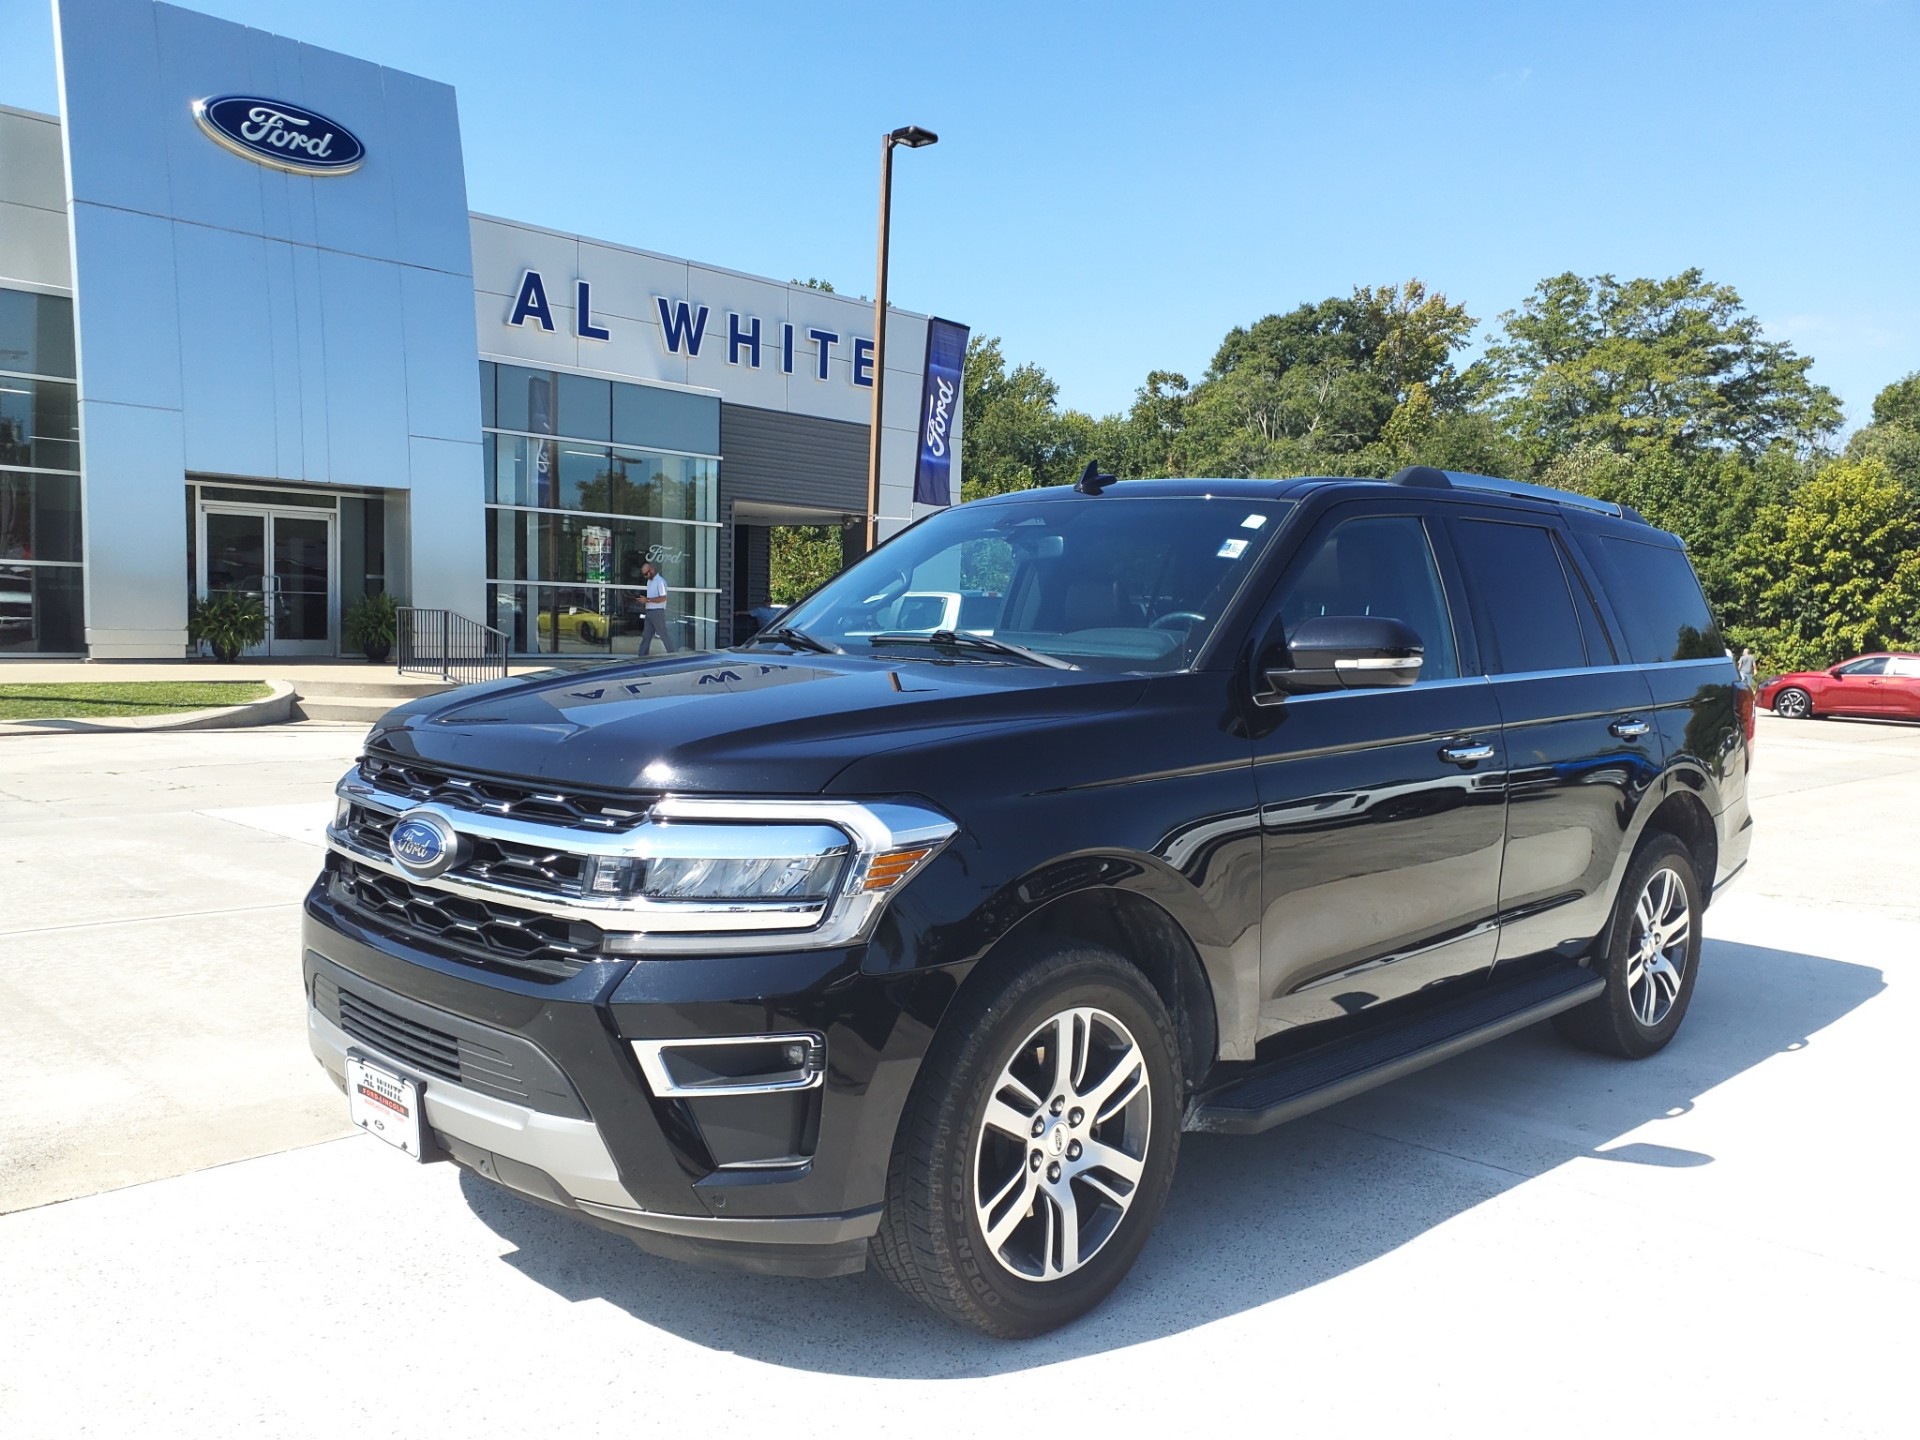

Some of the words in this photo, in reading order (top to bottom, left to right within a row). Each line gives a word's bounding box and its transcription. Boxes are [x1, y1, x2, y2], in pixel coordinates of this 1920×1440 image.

[240, 107, 332, 158] Ford
[507, 269, 610, 342] AL
[653, 295, 874, 388] WHITE
[926, 375, 954, 457] Ford
[645, 544, 682, 563] Ford
[397, 828, 431, 858] Ford
[362, 1087, 405, 1114] FORD-LINCOLN
